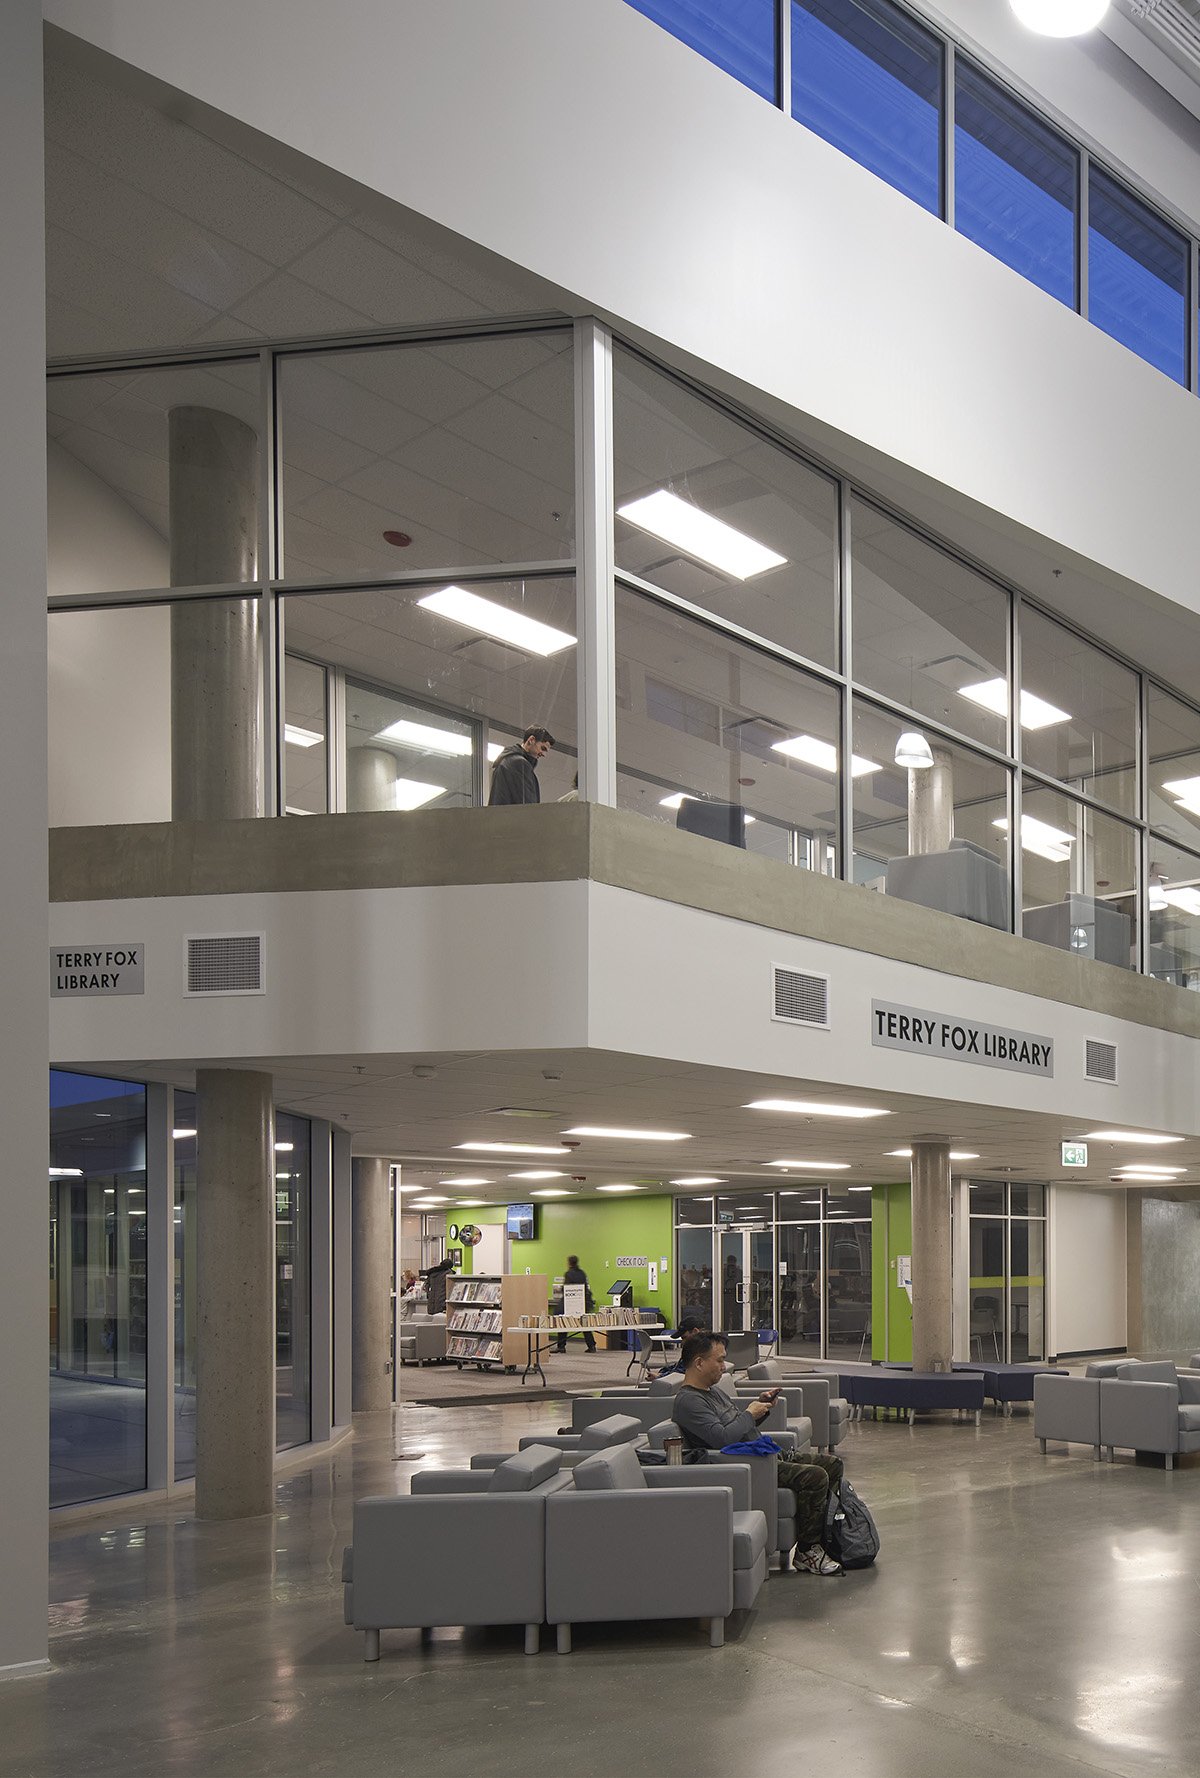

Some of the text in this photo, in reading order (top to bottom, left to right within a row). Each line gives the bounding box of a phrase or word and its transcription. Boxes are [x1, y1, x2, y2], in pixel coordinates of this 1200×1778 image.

[56, 951, 137, 968] TERRY FOX
[57, 973, 120, 989] LIBRARY
[875, 1010, 1051, 1067] TERRY FOX LIBRARY
[617, 1257, 632, 1266] CHECK
[637, 1257, 647, 1266] OUT
